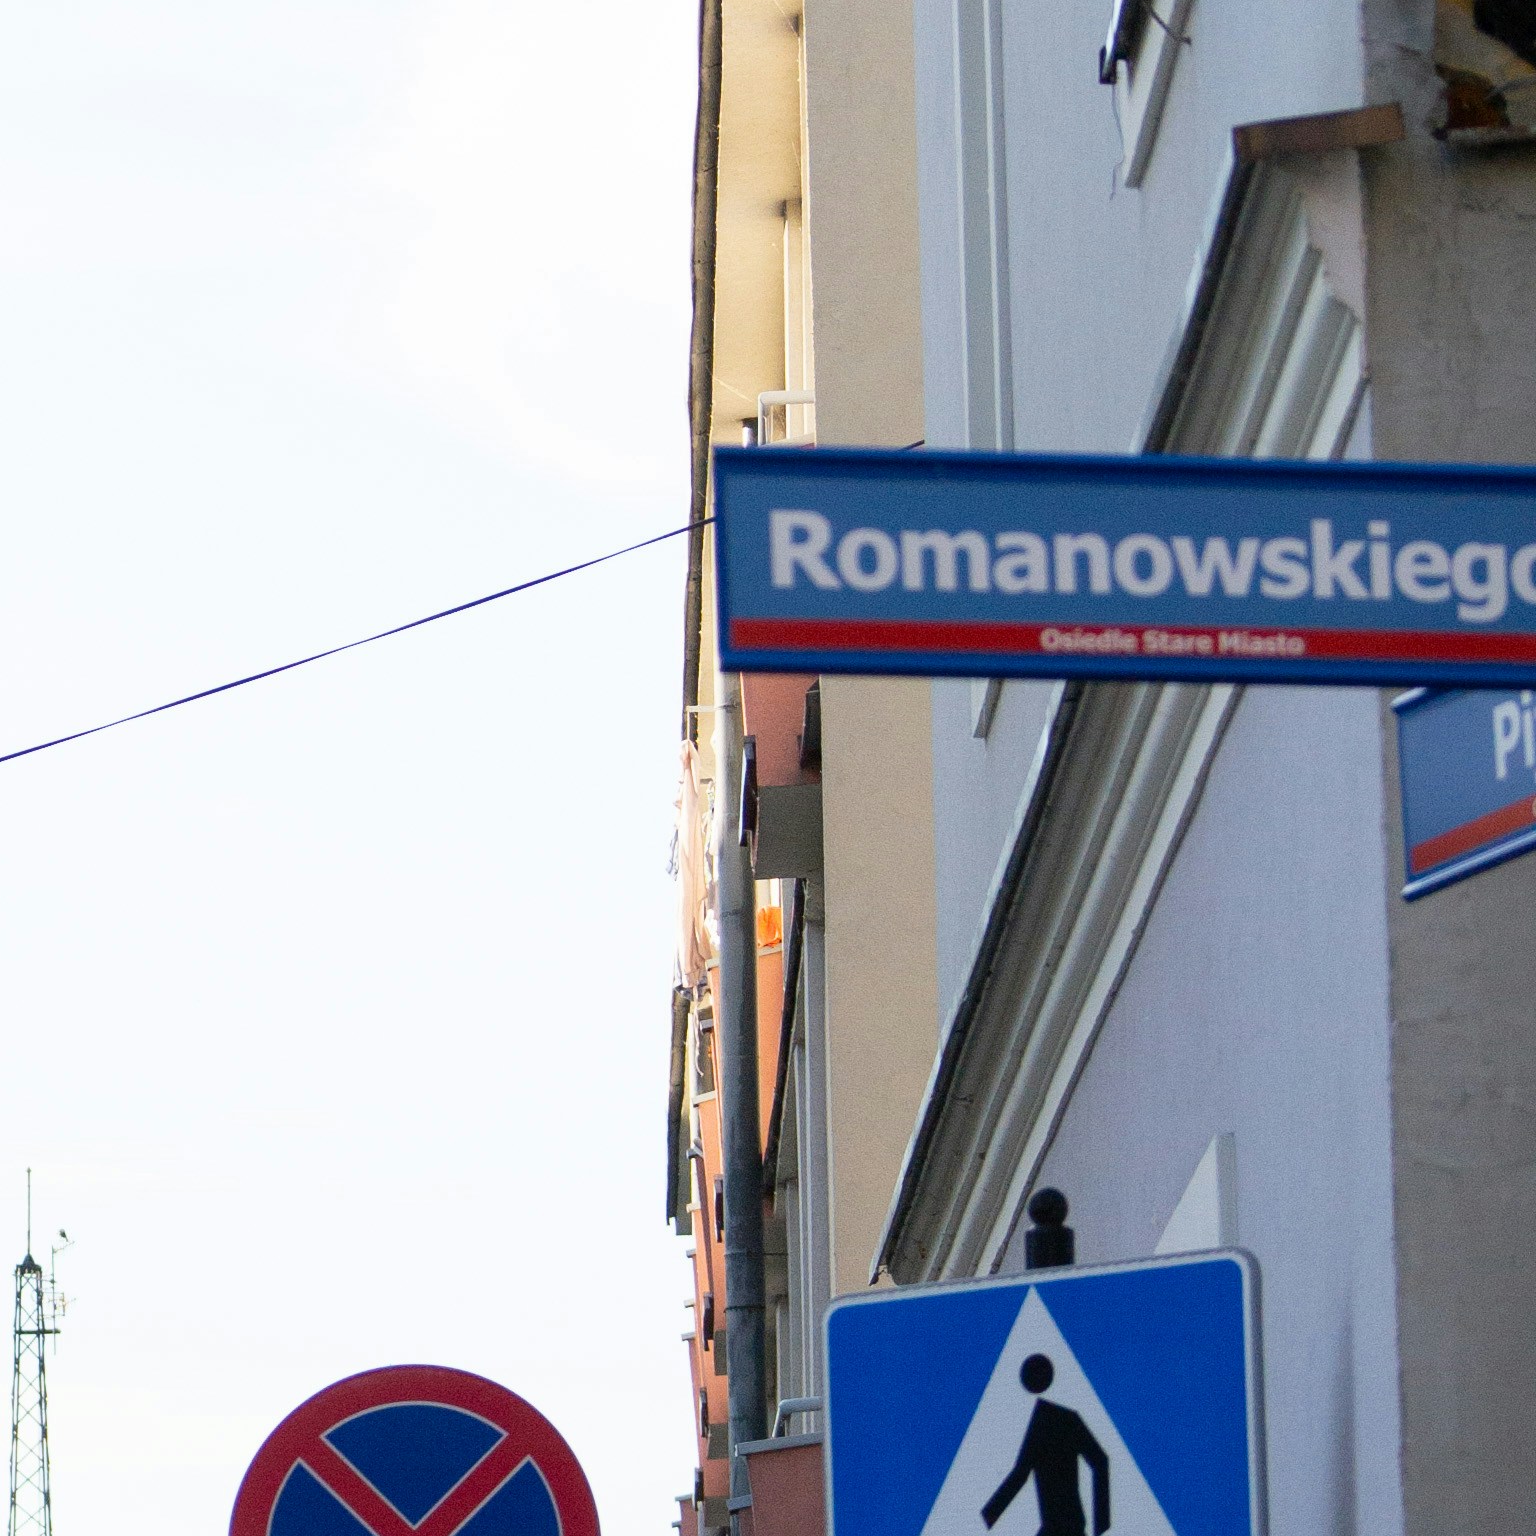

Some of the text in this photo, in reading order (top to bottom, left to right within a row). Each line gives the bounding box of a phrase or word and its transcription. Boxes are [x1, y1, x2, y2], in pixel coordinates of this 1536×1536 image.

[1040, 628, 1306, 656] Osiedle Stare Miasto
[1492, 689, 1536, 782] Pi
